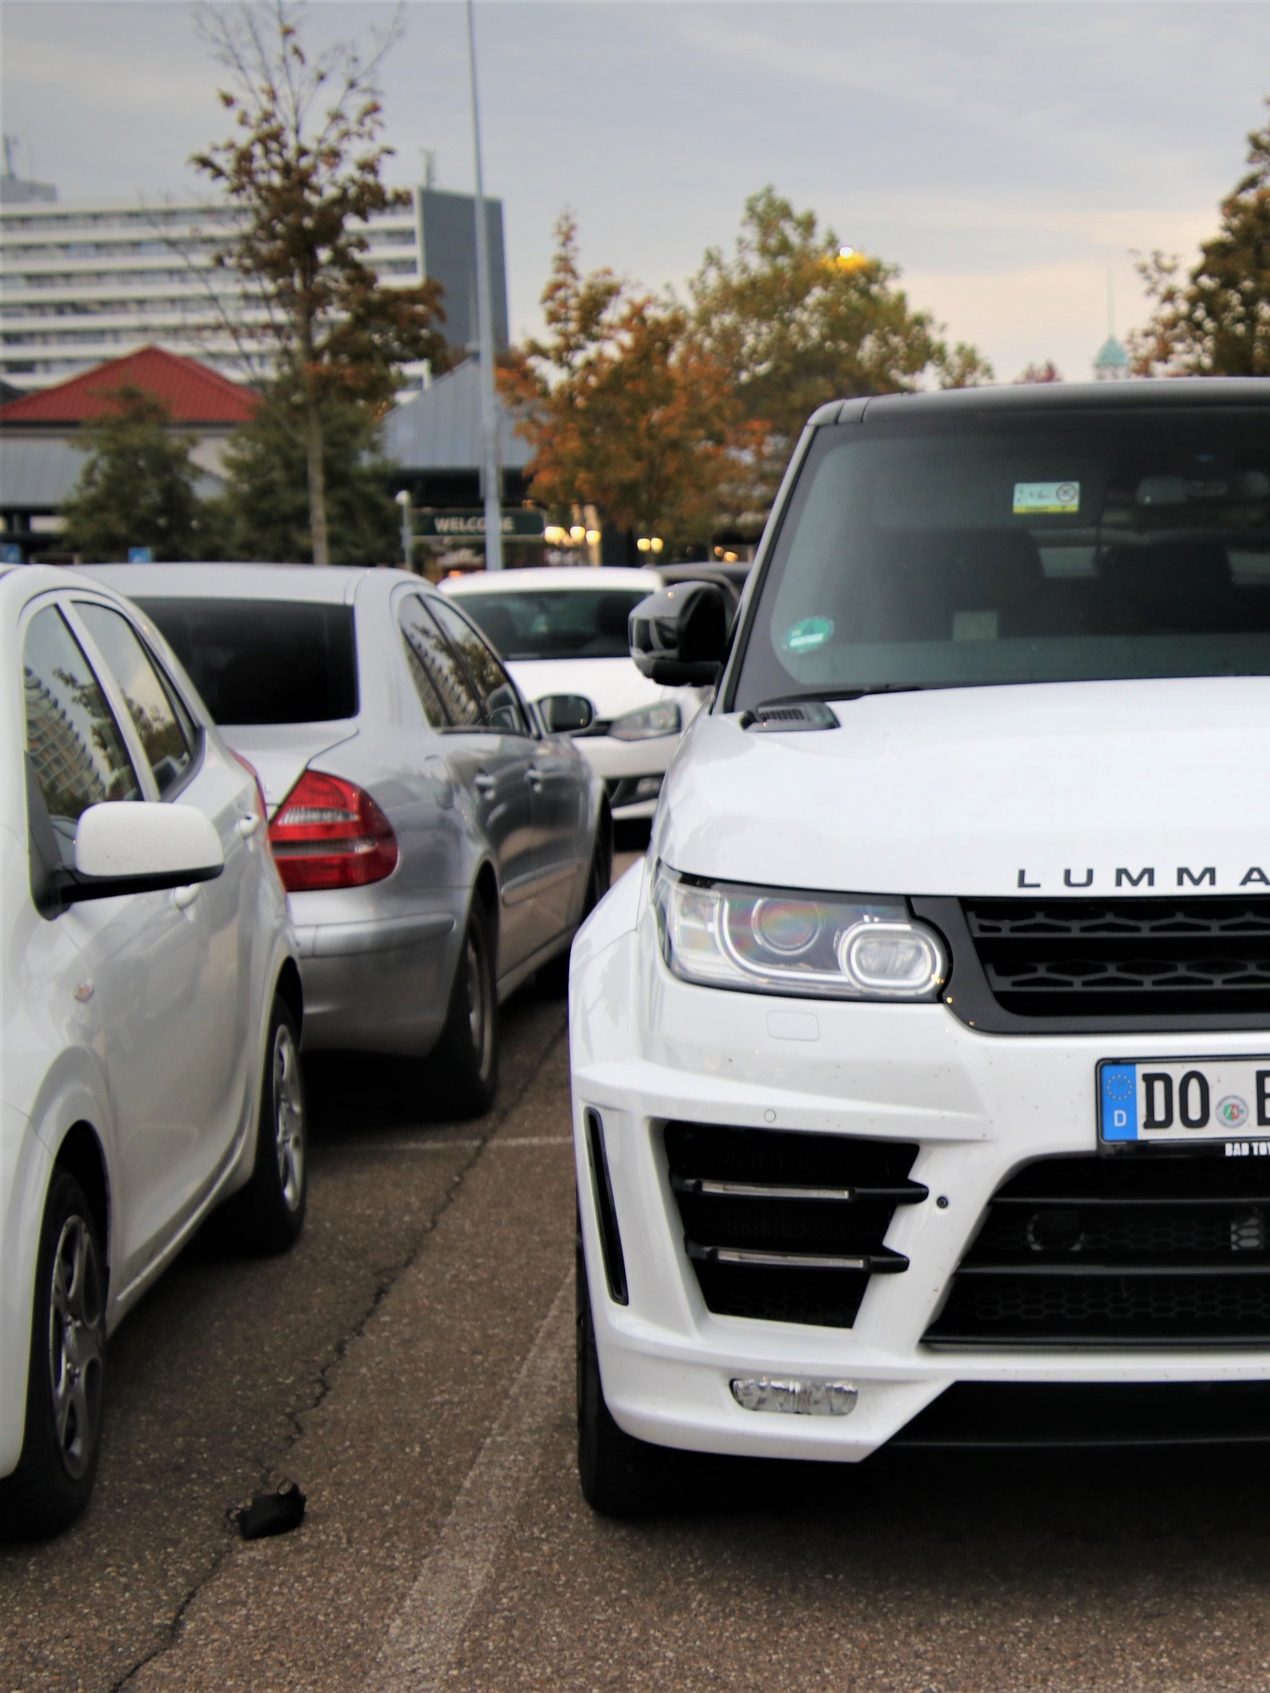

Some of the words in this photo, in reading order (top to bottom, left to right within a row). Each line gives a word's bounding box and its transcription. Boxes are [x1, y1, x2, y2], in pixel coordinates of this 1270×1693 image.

[434, 516, 514, 533] WELCOE
[1142, 1070, 1210, 1130] DO
[1114, 1109, 1127, 1127] D
[1224, 1142, 1250, 1157] BAD
